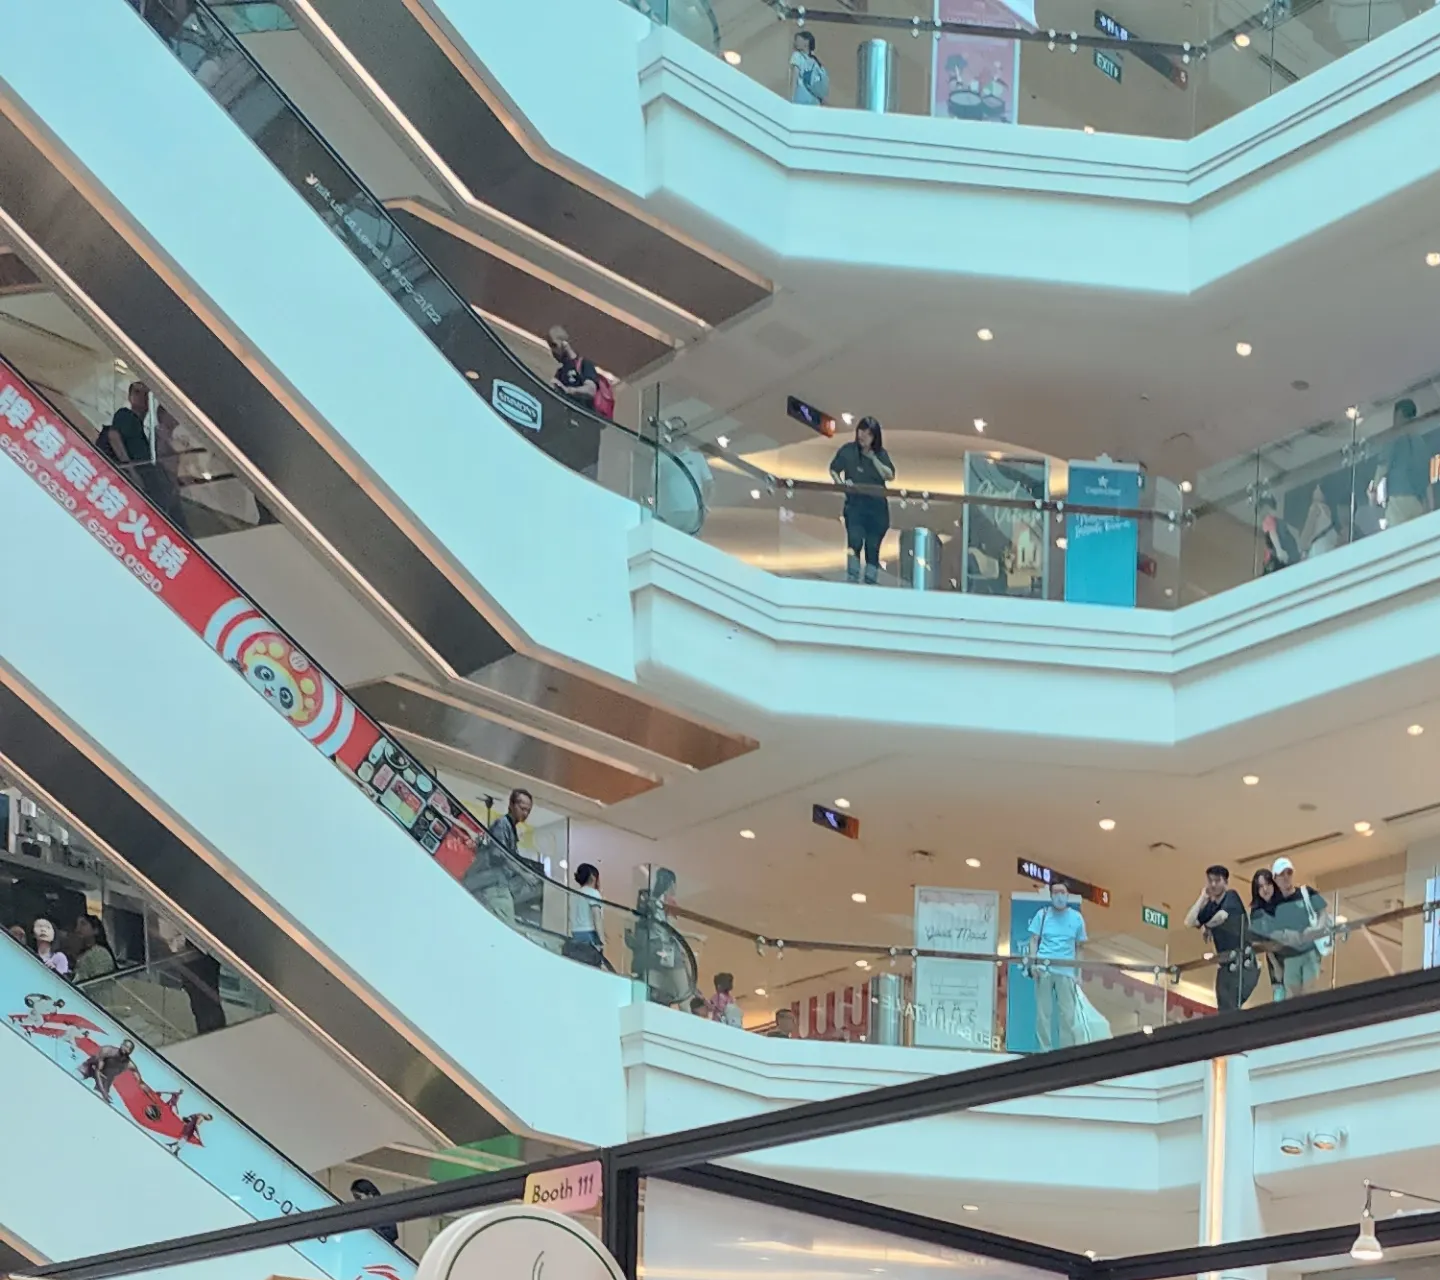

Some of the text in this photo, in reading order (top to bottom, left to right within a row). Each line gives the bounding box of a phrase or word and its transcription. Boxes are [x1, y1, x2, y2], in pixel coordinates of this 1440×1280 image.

[1096, 52, 1114, 77] EXIT
[87, 518, 125, 558] 6250
[1144, 908, 1162, 927] EXIT
[531, 1174, 594, 1204] Booth 111
